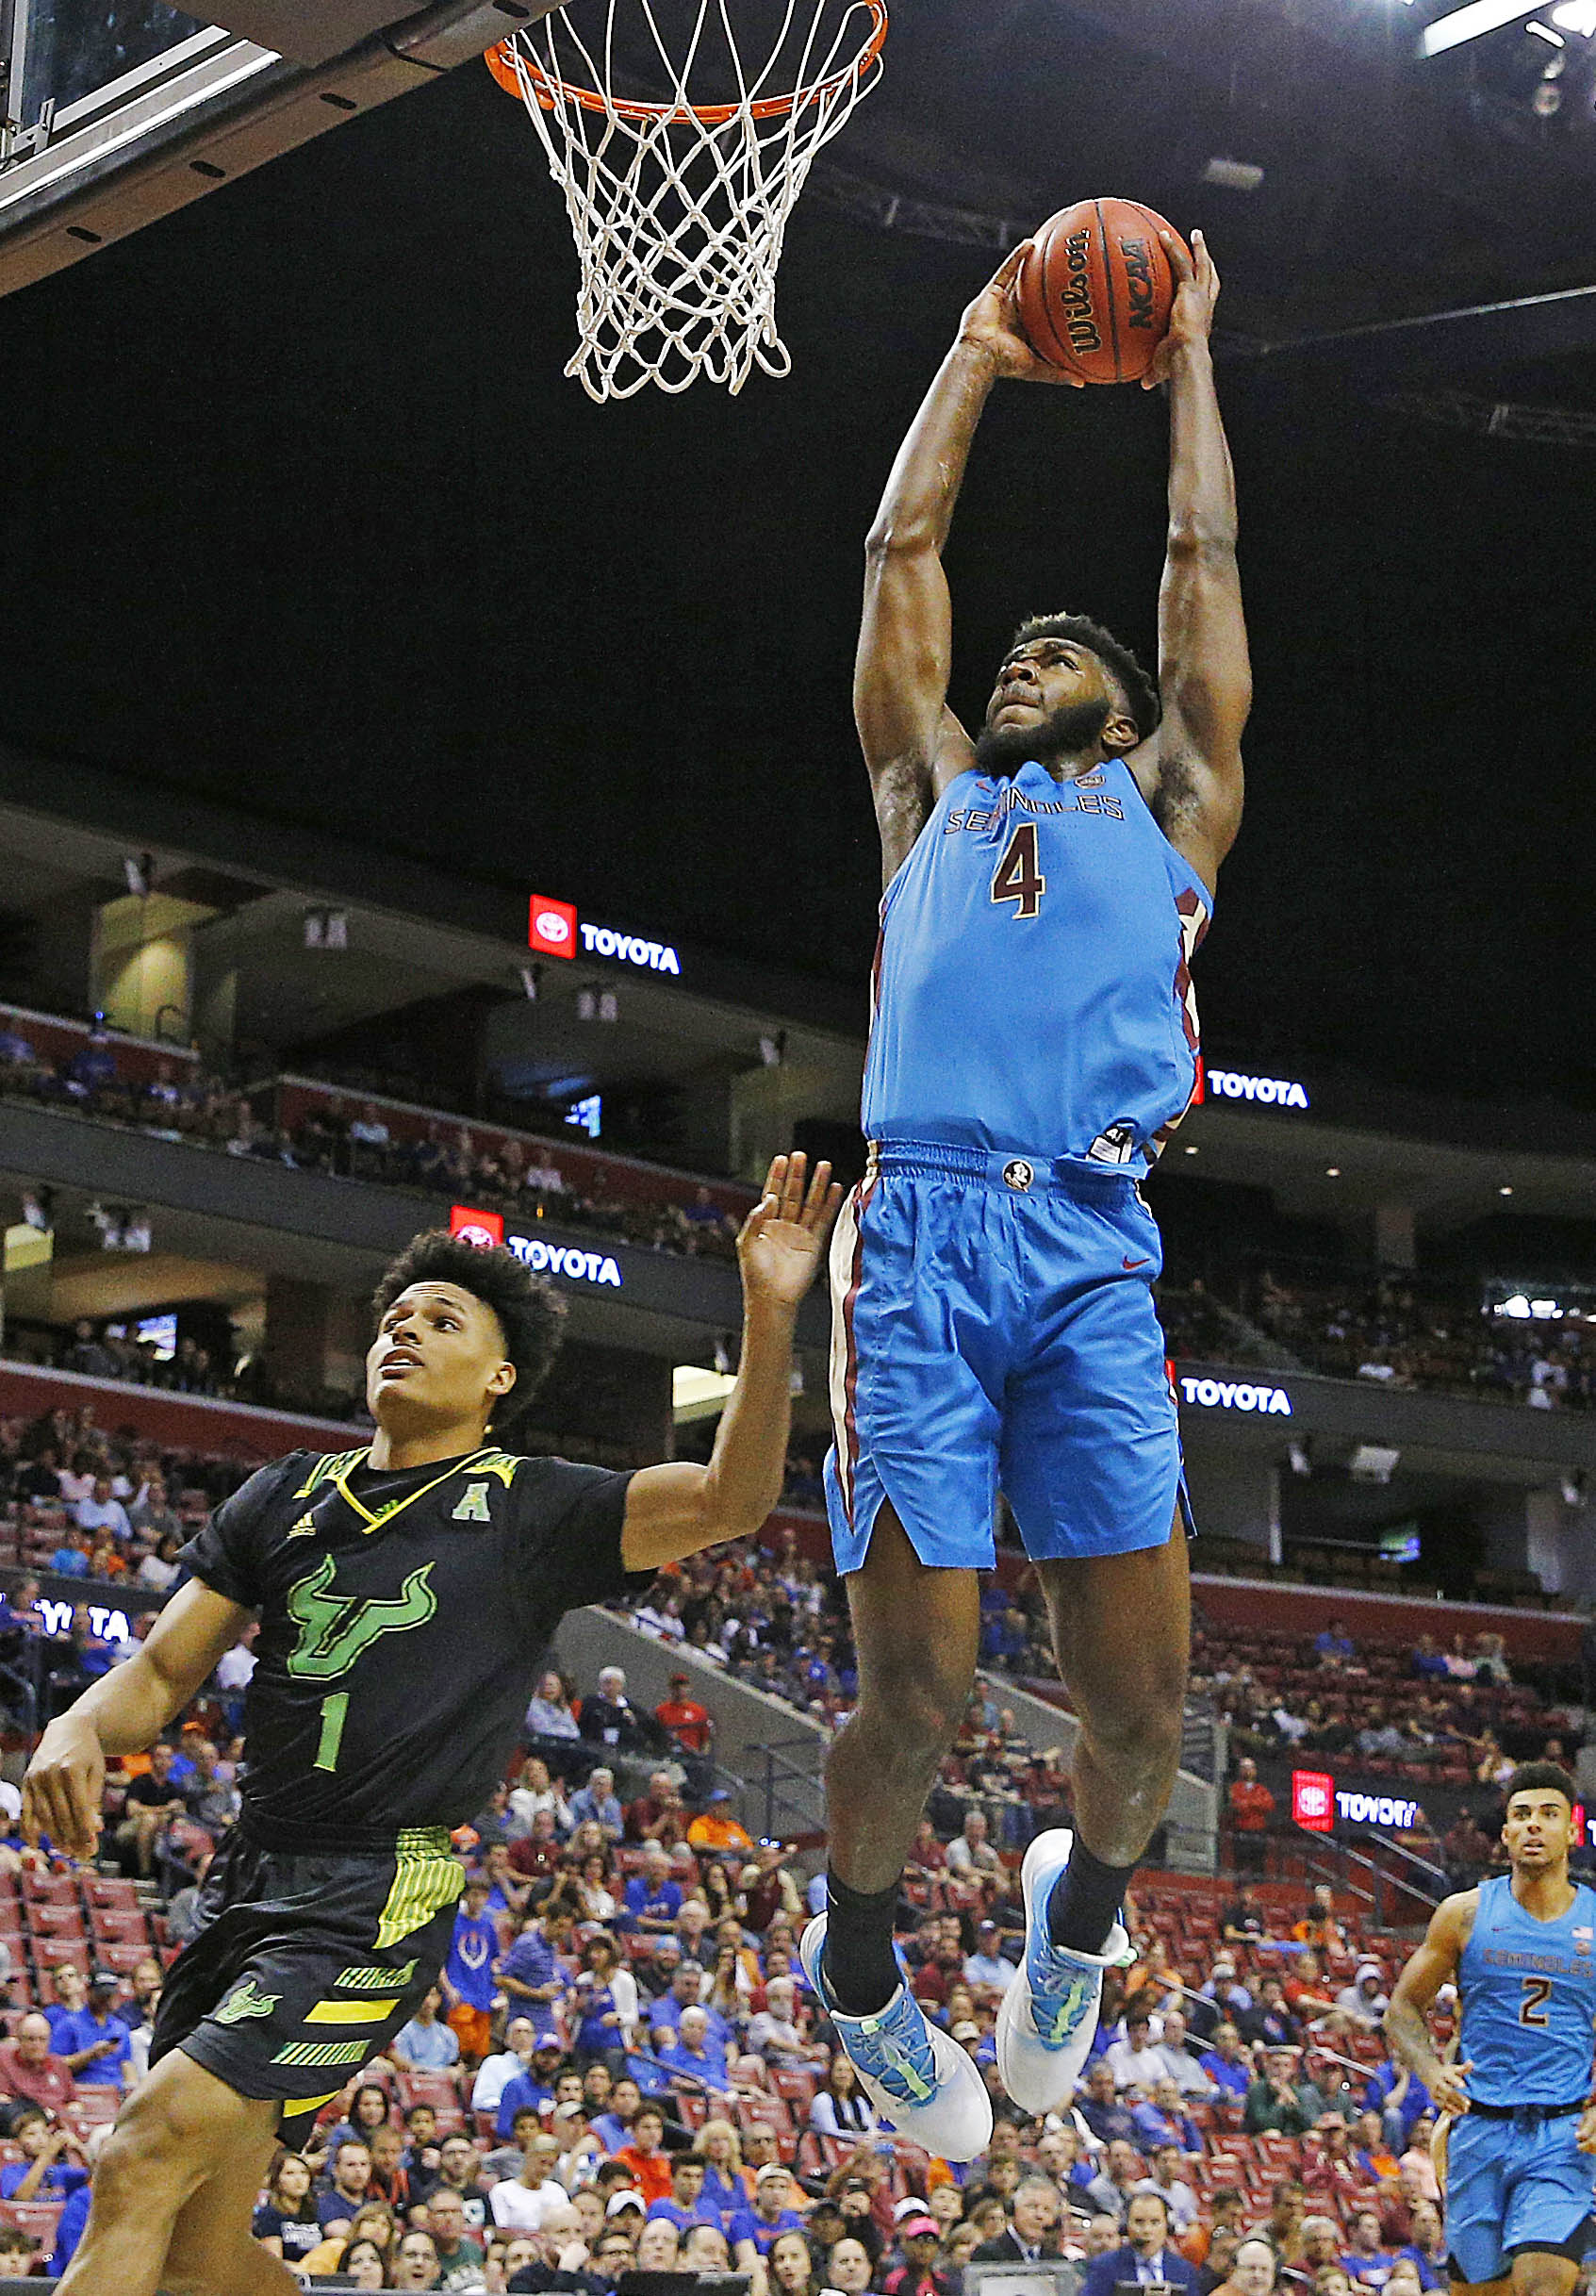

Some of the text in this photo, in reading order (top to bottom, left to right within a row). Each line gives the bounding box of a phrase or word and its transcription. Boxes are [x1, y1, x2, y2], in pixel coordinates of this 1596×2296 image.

[1061, 227, 1103, 356] Wilson
[1121, 237, 1155, 329] NCAA
[944, 786, 1125, 834] SENOLES
[990, 821, 1046, 920] 4
[580, 923, 681, 975] TOYOTA
[1207, 1069, 1309, 1109] TOYOTA
[507, 1235, 623, 1288] TOYOTA
[1179, 1377, 1292, 1416] TOYOTA
[312, 1692, 350, 1773] 1
[1518, 1975, 1554, 2028] 2
